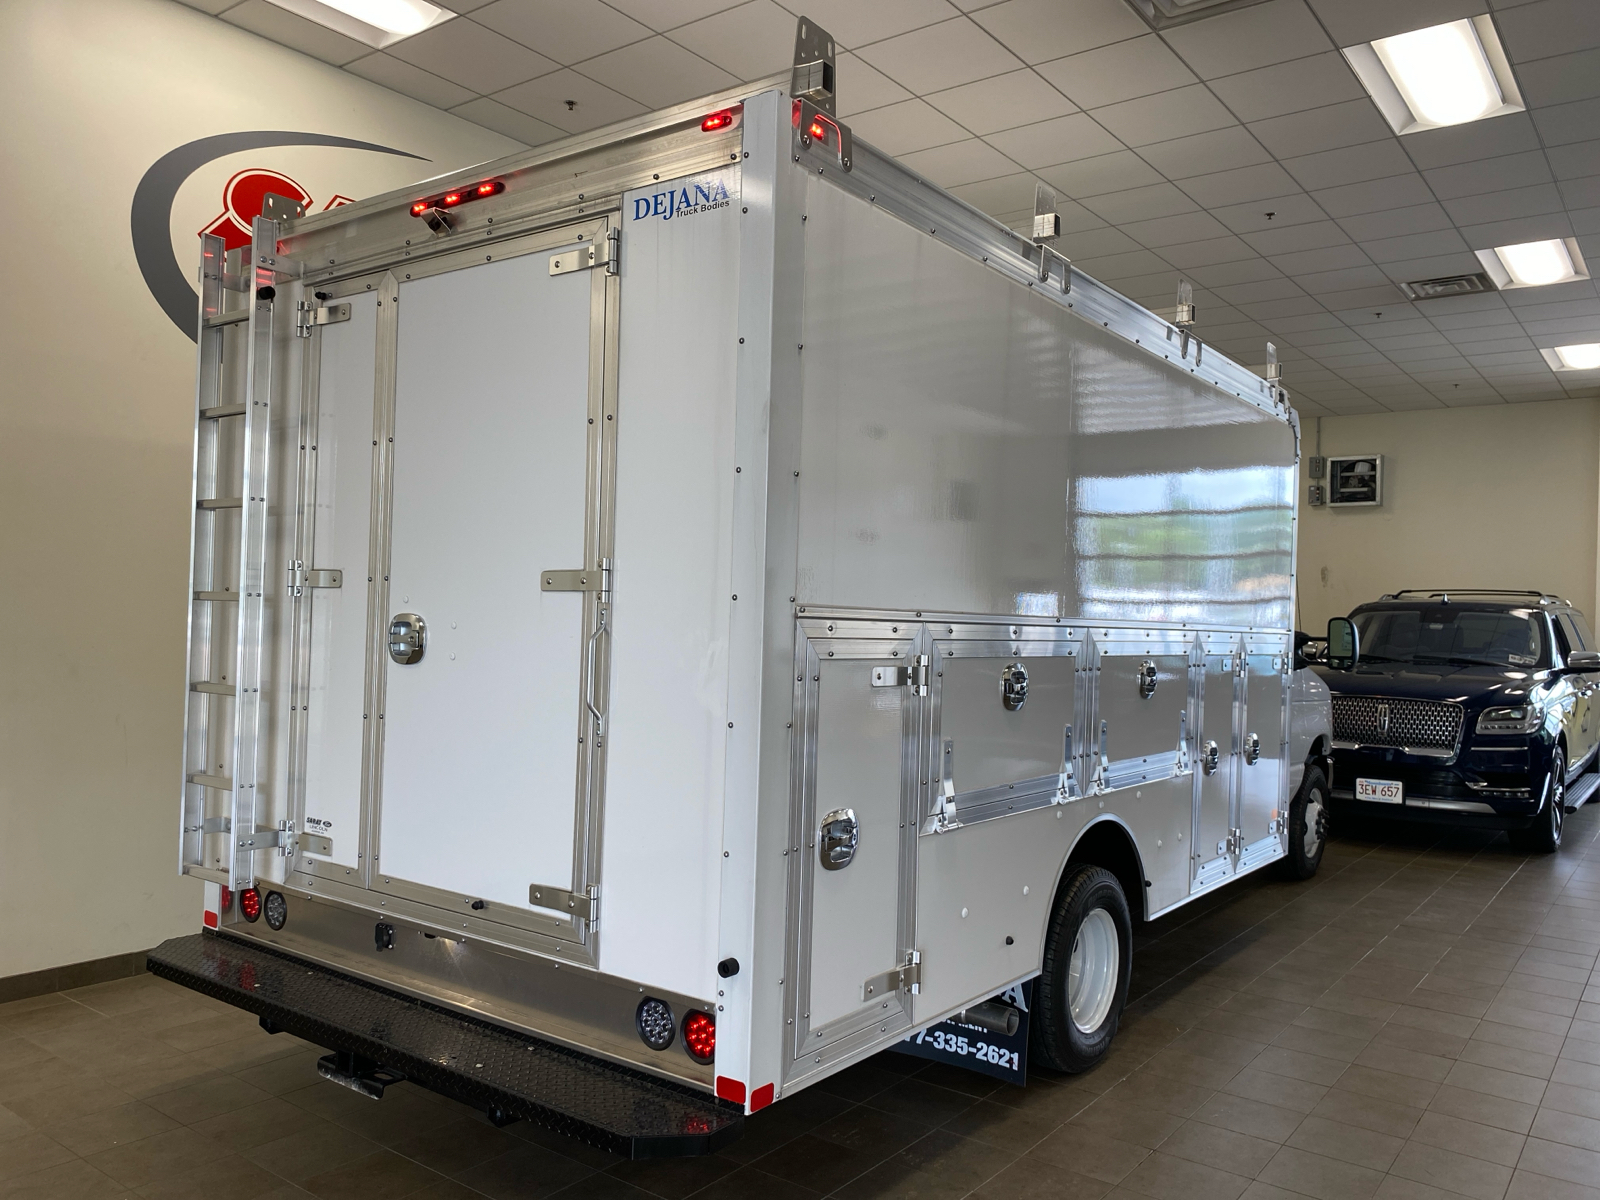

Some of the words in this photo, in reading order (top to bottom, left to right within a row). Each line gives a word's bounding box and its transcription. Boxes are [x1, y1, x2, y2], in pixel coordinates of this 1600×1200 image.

[633, 178, 730, 221] DEJANA
[675, 206, 699, 218] Truck
[700, 200, 730, 213] Bodies
[1380, 786, 1400, 797] 657
